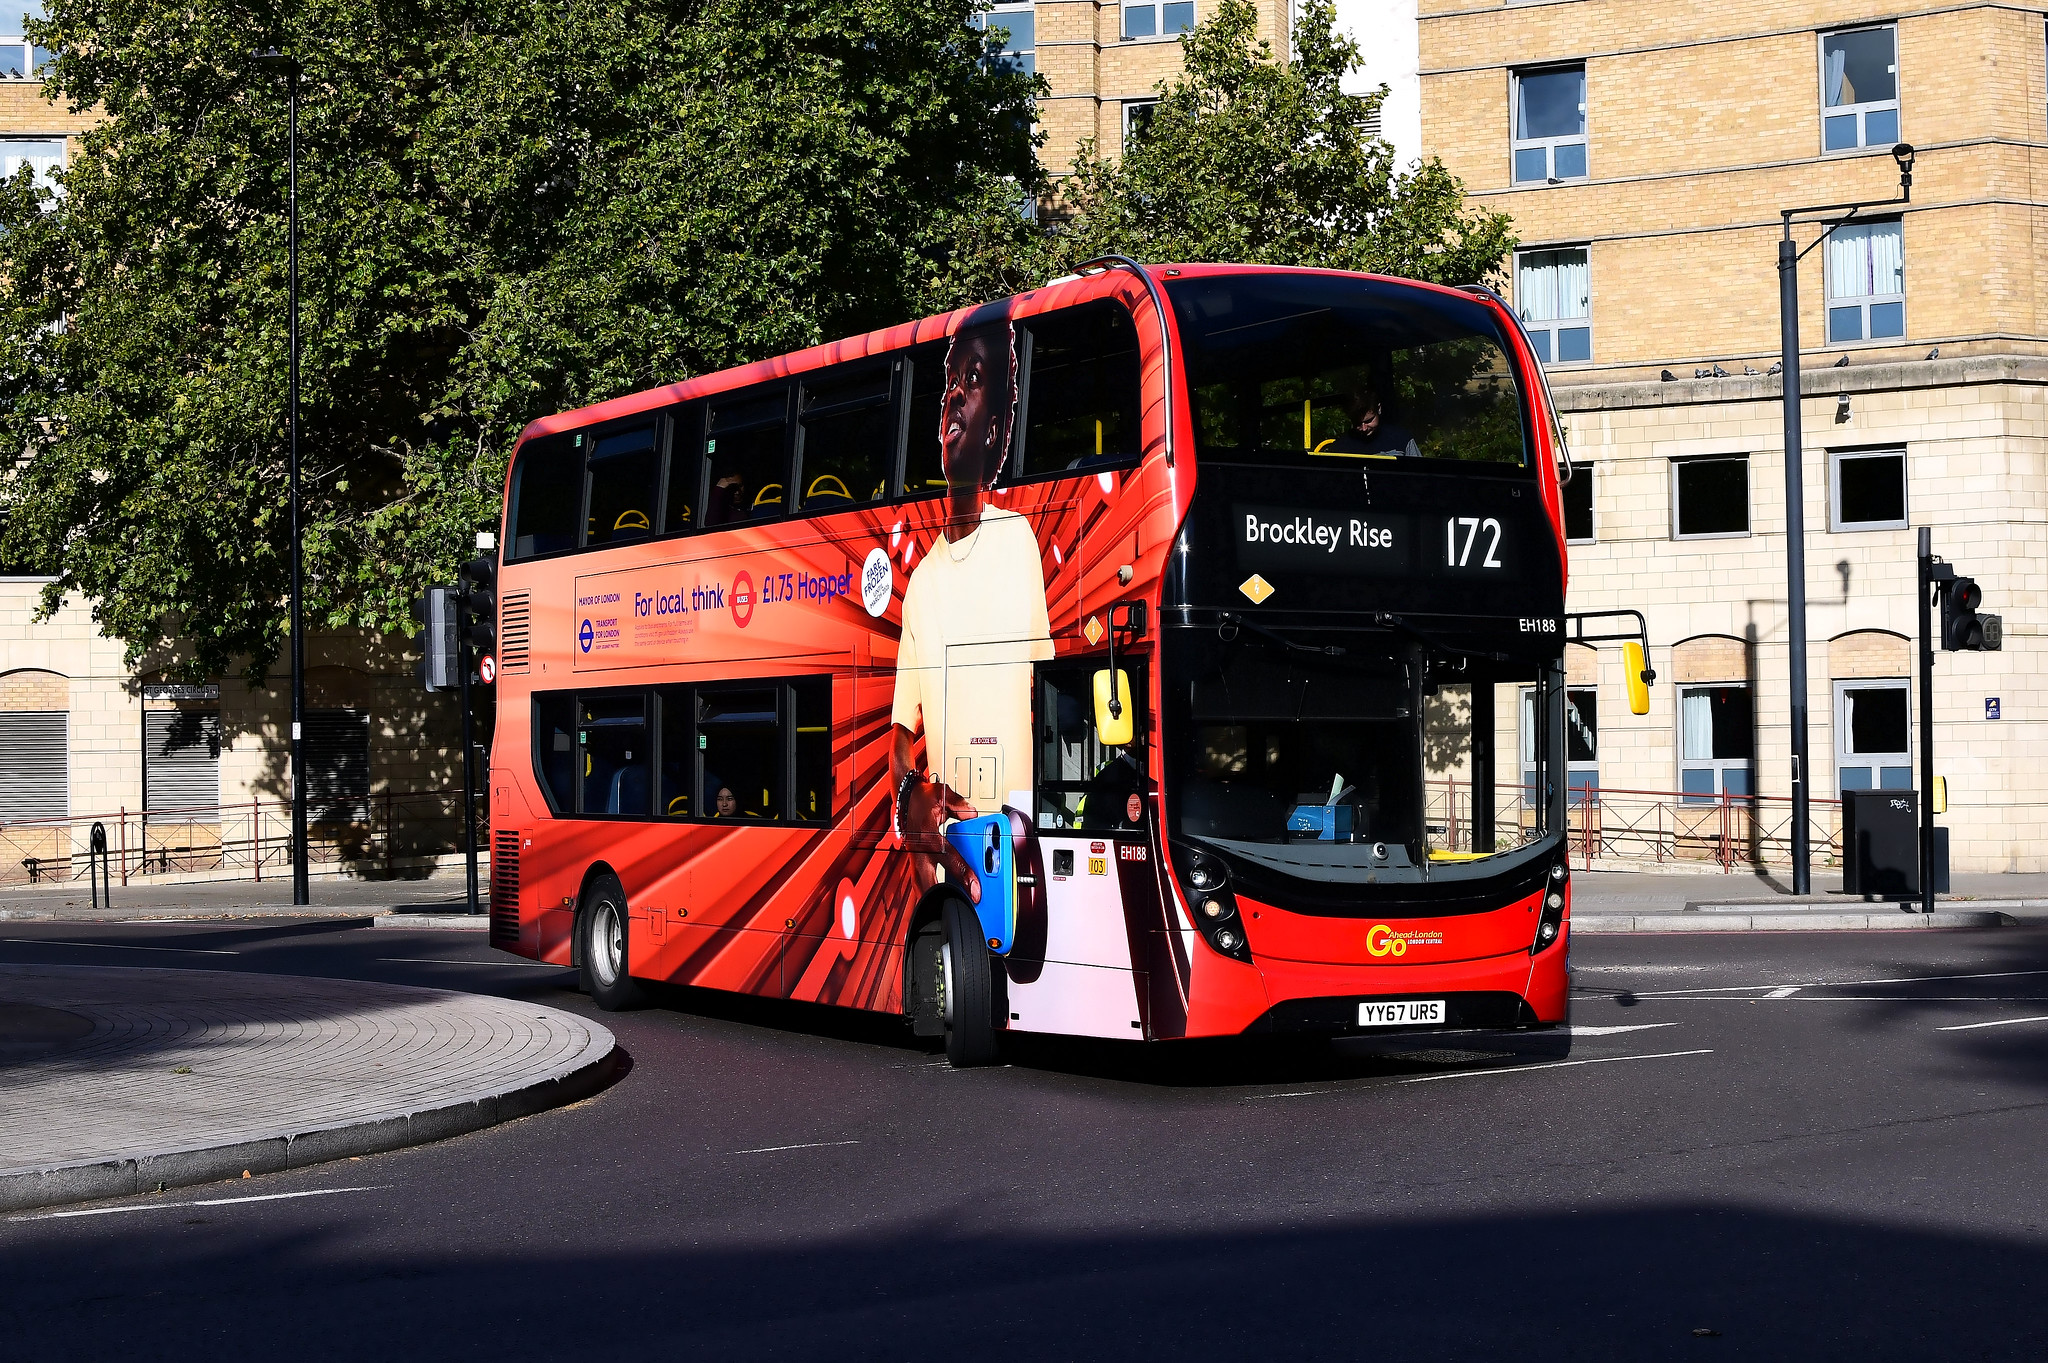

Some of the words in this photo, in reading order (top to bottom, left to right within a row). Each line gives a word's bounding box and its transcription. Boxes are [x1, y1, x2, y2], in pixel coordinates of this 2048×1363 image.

[1245, 514, 1342, 553] Brockley
[1349, 519, 1393, 548] Rise
[1447, 516, 1502, 568] 172
[866, 558, 881, 581] FARE
[864, 562, 888, 598] FROZEN
[578, 596, 594, 607] MAYOR
[594, 594, 601, 604] OF
[600, 592, 620, 604] LONDON
[634, 592, 653, 617] For
[656, 587, 688, 616] local,
[691, 582, 725, 611] think
[762, 573, 793, 604] £1.75
[797, 571, 853, 605] Hopper
[870, 591, 882, 609] MARCH
[595, 618, 618, 628] TRANSPORT
[1518, 618, 1557, 633] EH188
[595, 629, 603, 639] FOR
[603, 629, 620, 638] LONDON
[144, 686, 153, 694] ST
[186, 686, 210, 694] CIRCUS
[1120, 845, 1147, 861] EH188
[1090, 859, 1104, 874] 103
[1366, 924, 1407, 957] Go
[1389, 930, 1442, 938] Ahead-London
[1366, 1004, 1406, 1022] YY67
[1409, 1003, 1438, 1020] URS
